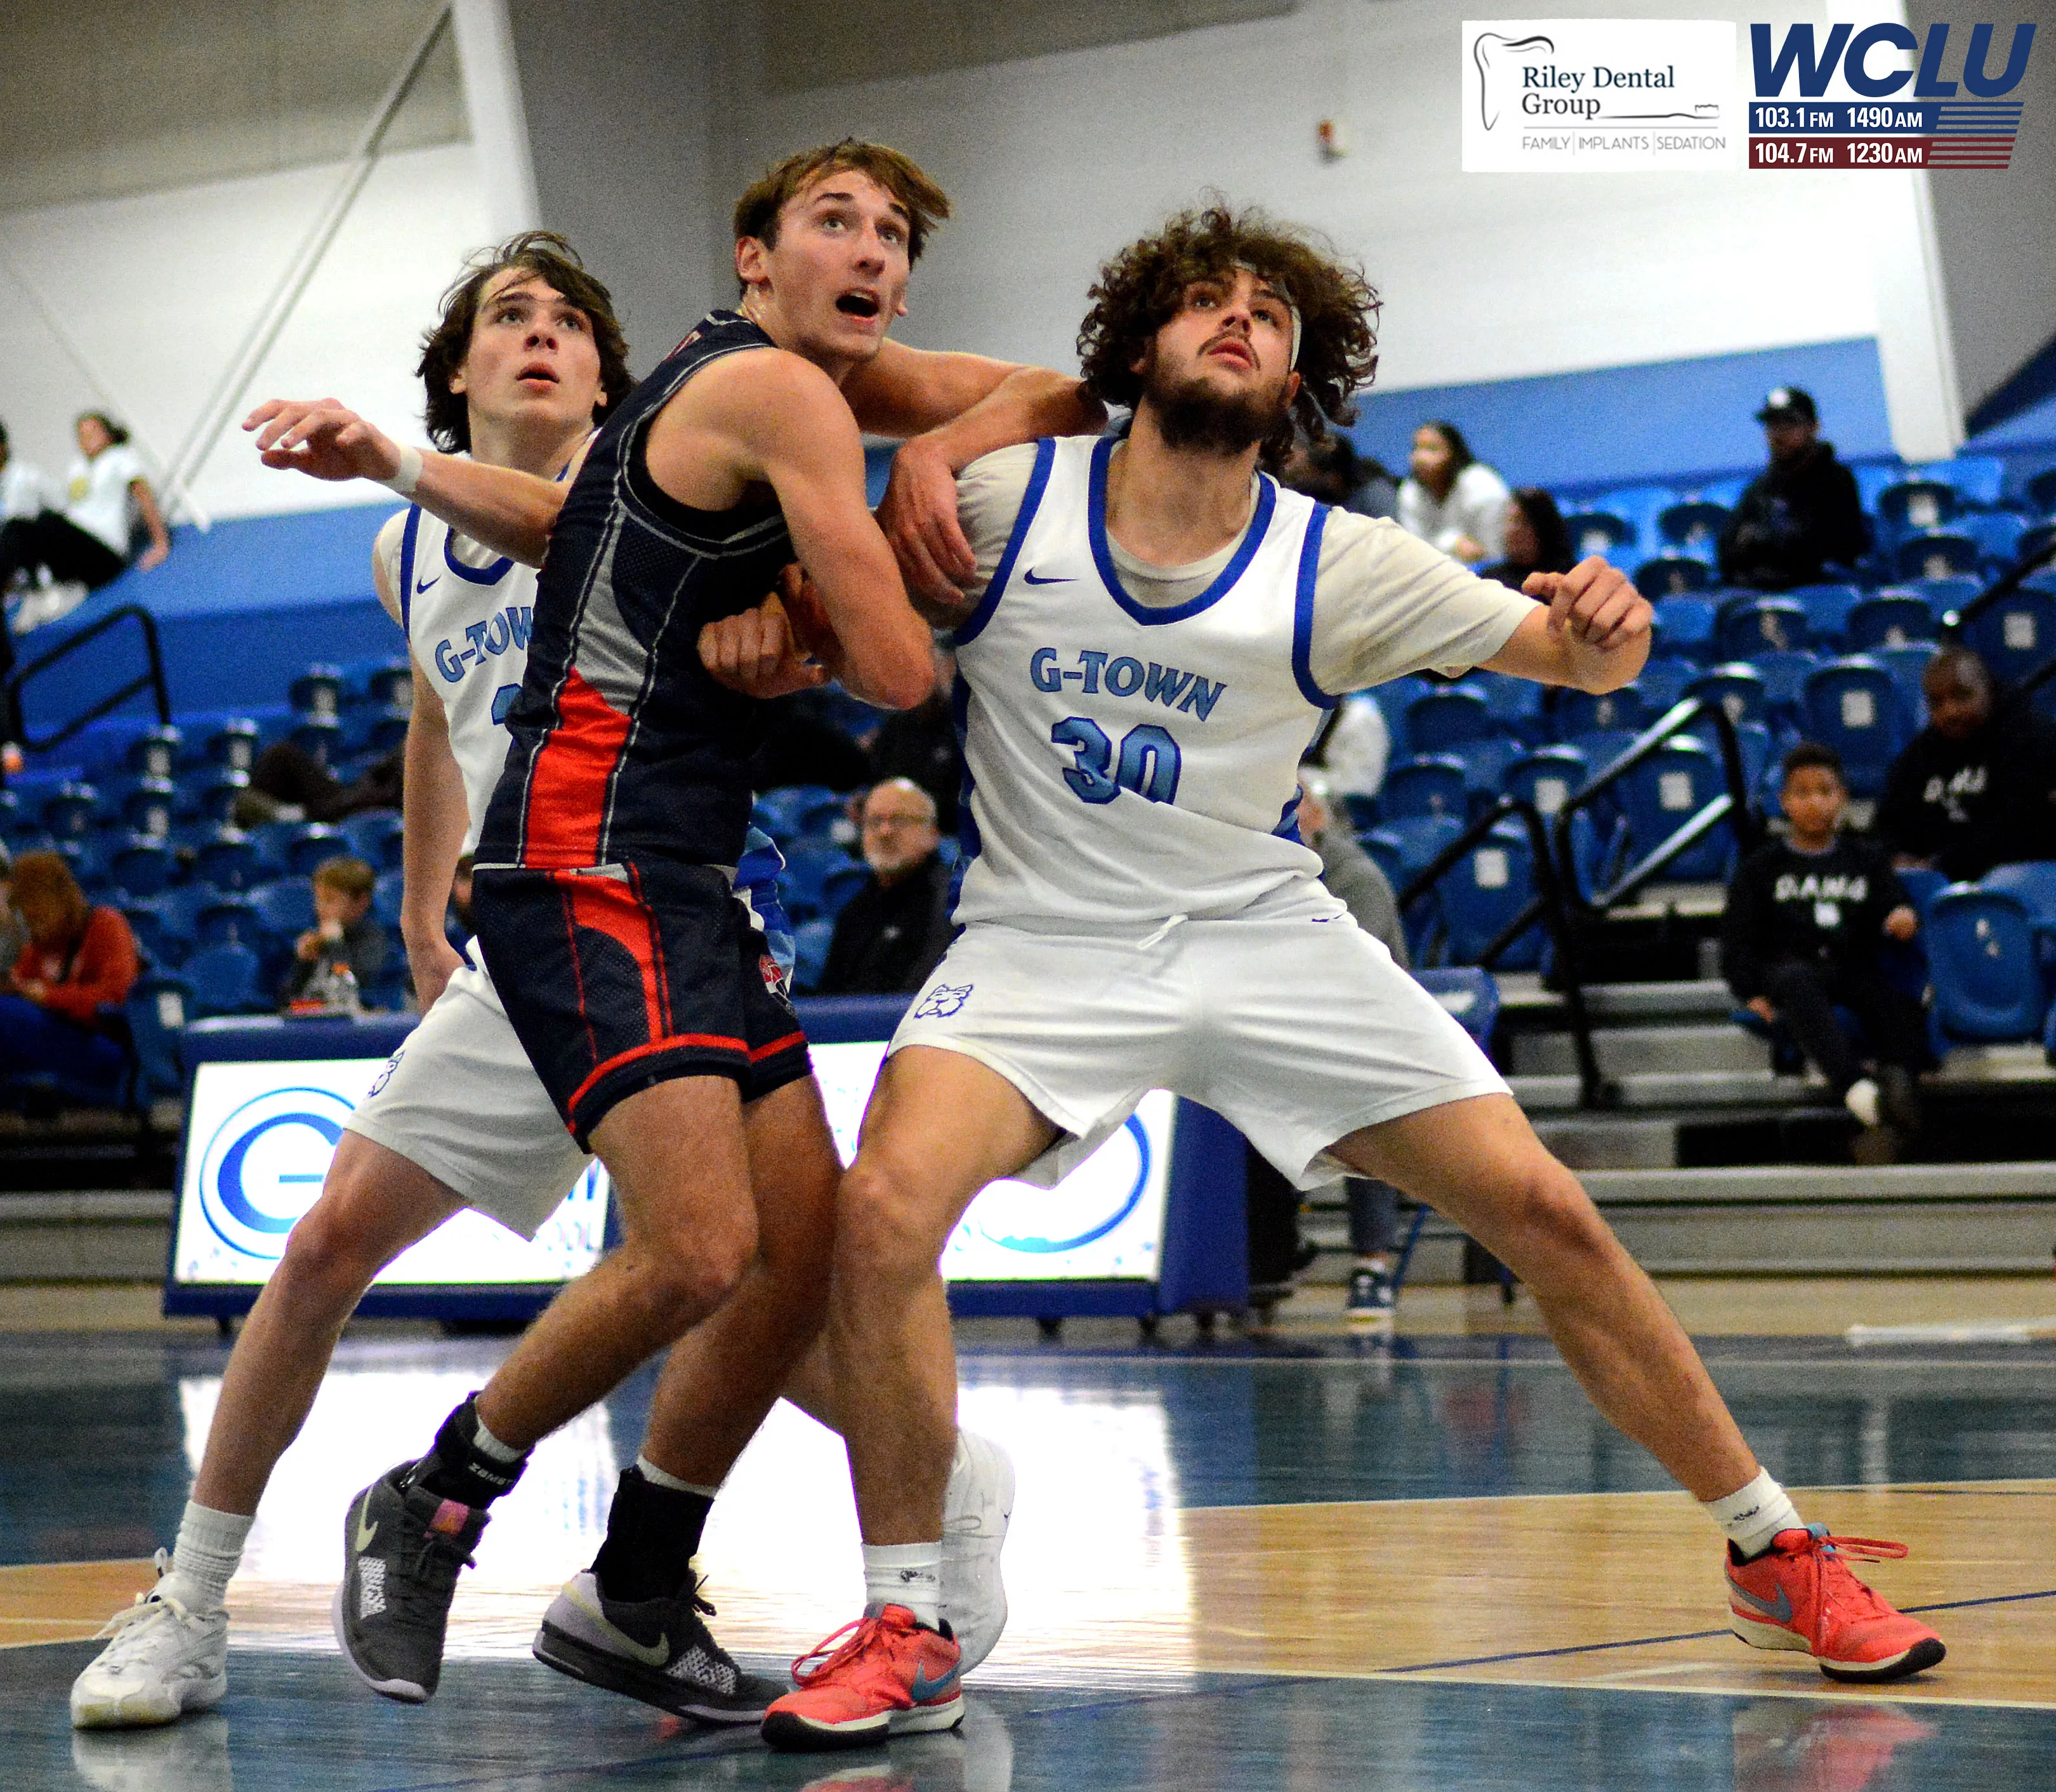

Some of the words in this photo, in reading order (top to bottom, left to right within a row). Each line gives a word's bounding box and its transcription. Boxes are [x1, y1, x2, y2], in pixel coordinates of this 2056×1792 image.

[435, 606, 534, 683] G-TOW
[1030, 647, 1227, 721] G-TOWN
[1051, 716, 1182, 805] 30
